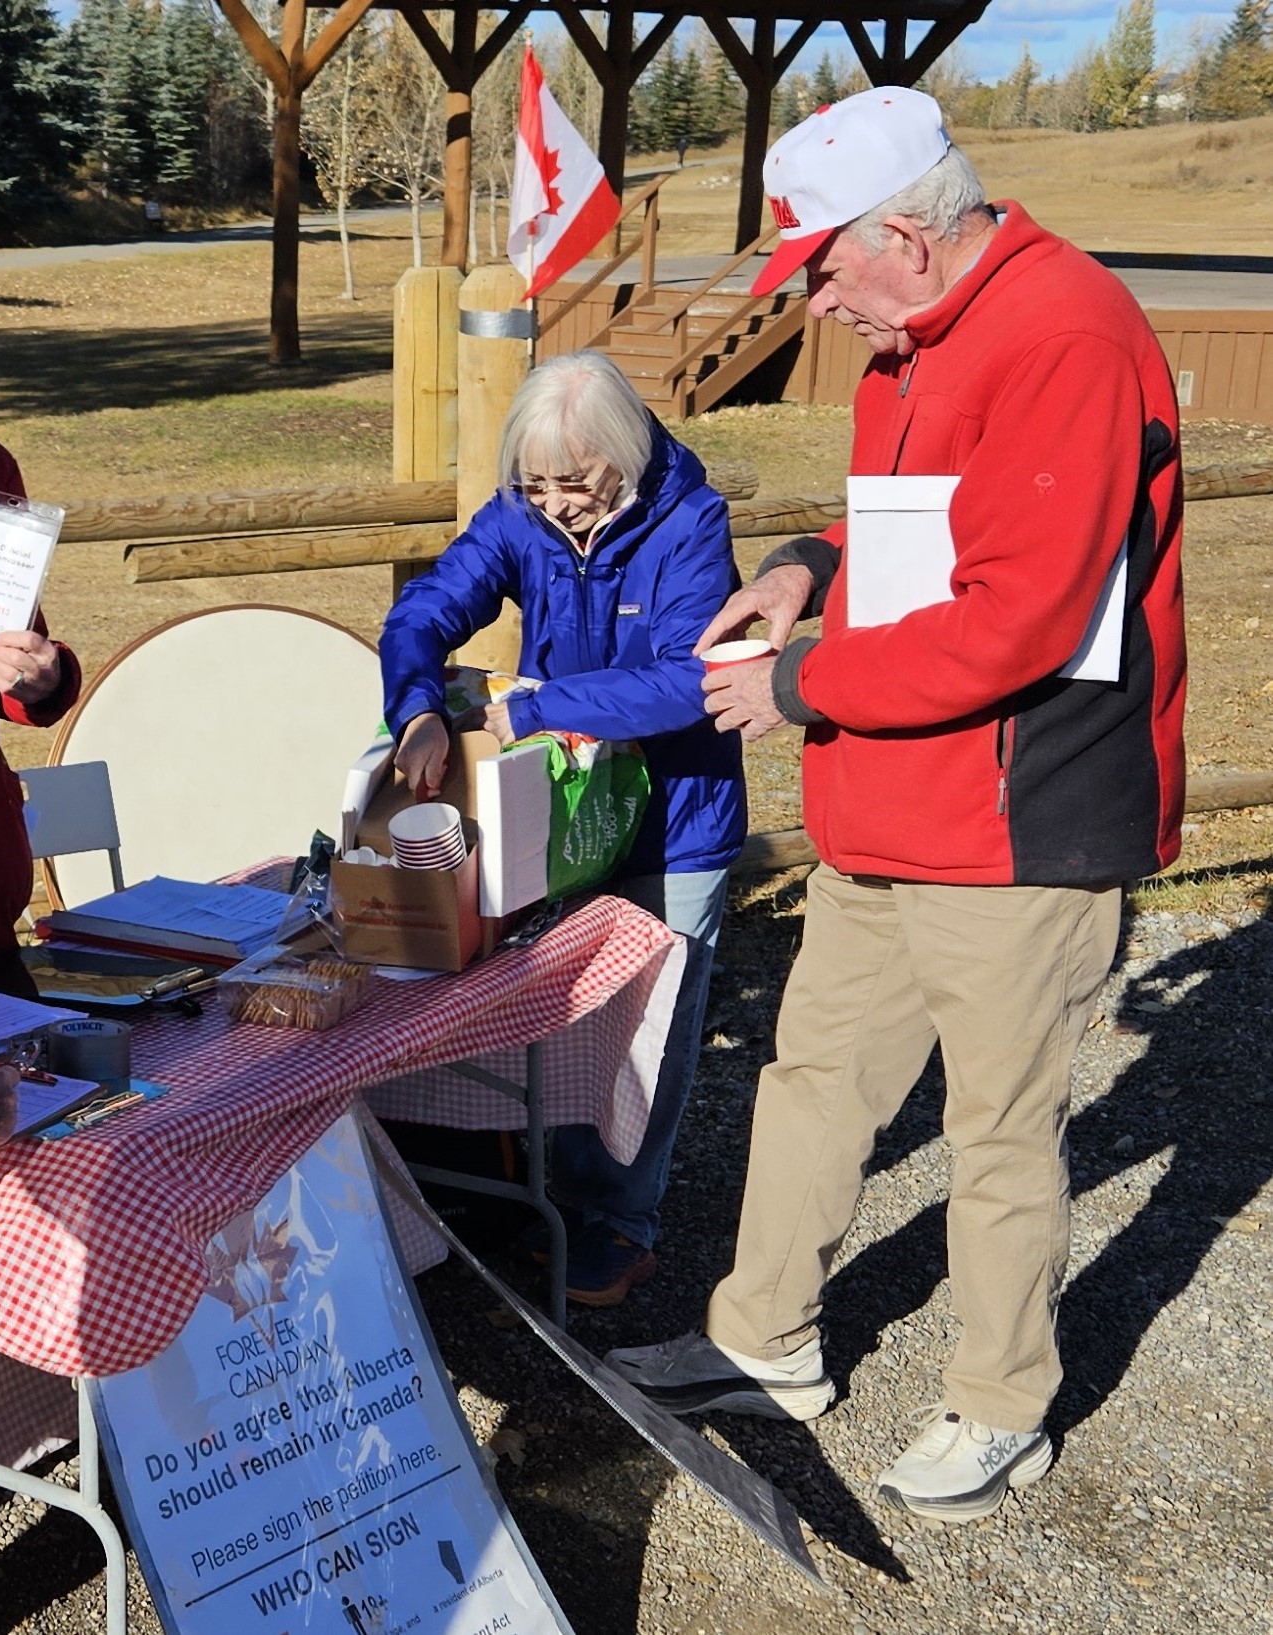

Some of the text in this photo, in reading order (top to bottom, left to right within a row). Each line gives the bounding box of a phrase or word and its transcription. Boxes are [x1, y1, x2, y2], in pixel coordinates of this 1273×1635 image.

[145, 1346, 416, 1482] Do you agree that Alberta
[229, 1334, 332, 1398] CANADIAN
[158, 1374, 424, 1519] should remain in Canada?
[191, 1444, 442, 1578] Please sign the petition here.
[250, 1511, 421, 1617] WHO CAN SIGN
[438, 1587, 470, 1611] resident
[469, 1581, 478, 1592] of
[477, 1568, 504, 1589] Alberta
[492, 1612, 512, 1632] Act
